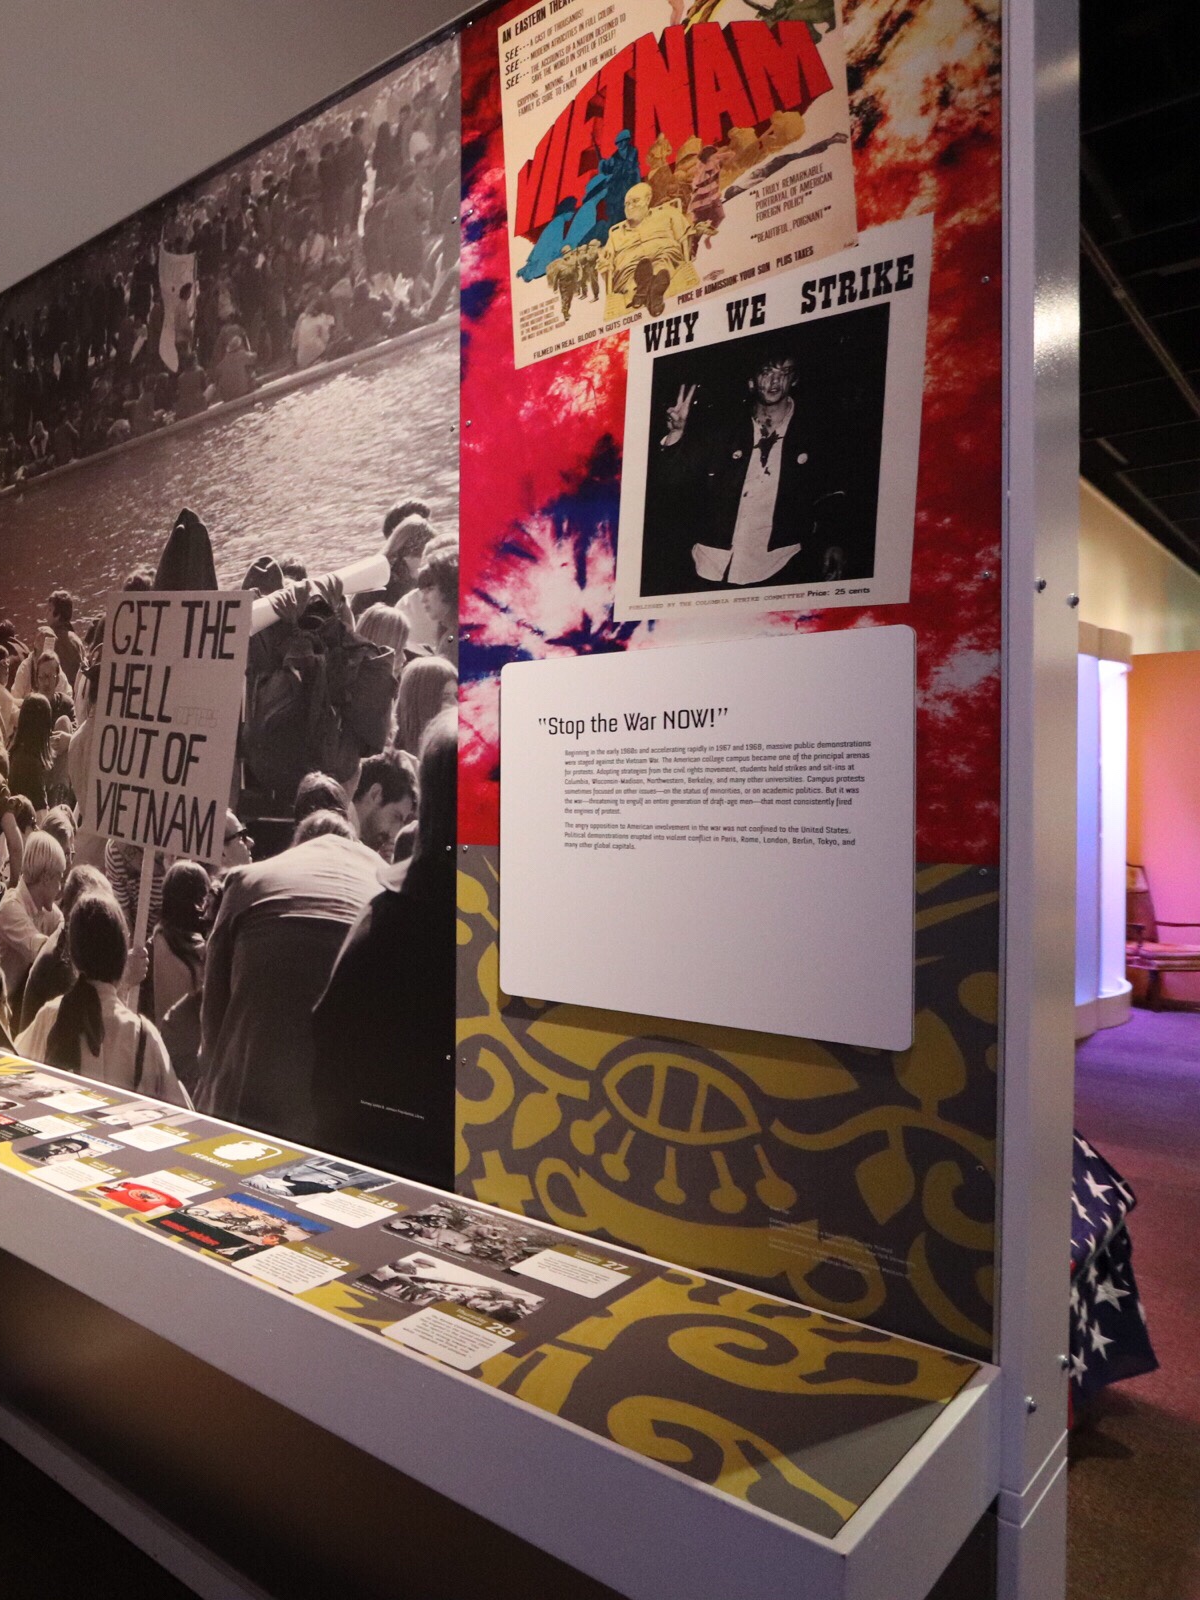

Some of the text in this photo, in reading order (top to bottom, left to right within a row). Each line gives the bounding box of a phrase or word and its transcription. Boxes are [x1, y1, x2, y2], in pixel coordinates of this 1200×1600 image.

[502, 5, 547, 44] AN EASTERN
[530, 4, 615, 60] MODERN ATROCITIES IN FULL COLOR!
[534, 8, 584, 44] CAST OF THOUSANDS!
[531, 13, 626, 74] THE ACCOUNTS NATION DESTINED TO
[531, 29, 616, 84] SAVE WORLD IN SPITE ITSELF!
[514, 20, 833, 238] VIETNAM
[755, 172, 833, 211] PORTRAYAL OF AMERICAN
[762, 163, 823, 196] TRULY REMARKABLE
[756, 204, 782, 222] FOREIGN
[677, 245, 814, 305] PRICE OF ADMISSION: YOUR SON PLUS TAXES
[643, 253, 915, 353] WHY WE STRIKE
[533, 312, 643, 359] FILMED IN REAL BLOOD GUTS COLOR
[807, 589, 830, 597] Price:
[848, 586, 870, 595] cents
[111, 600, 241, 660] GET THE
[105, 661, 172, 723] HELL
[590, 711, 618, 733] the
[624, 712, 657, 731] War
[99, 724, 207, 787] OUT OF
[793, 754, 799, 762] of
[814, 752, 844, 762] principal
[794, 742, 814, 750] public
[817, 740, 872, 749] demonstrations
[96, 779, 217, 859] VIETNAM
[763, 836, 790, 845] London,
[792, 837, 815, 845] Berlin,
[818, 838, 840, 847] Tokyo,
[191, 1152, 233, 1169] FEBRUARY
[198, 1177, 216, 1188] 16
[379, 1199, 398, 1209] 19
[324, 1256, 349, 1268] 22
[602, 1260, 629, 1271] 27
[485, 1322, 516, 1337] 29
